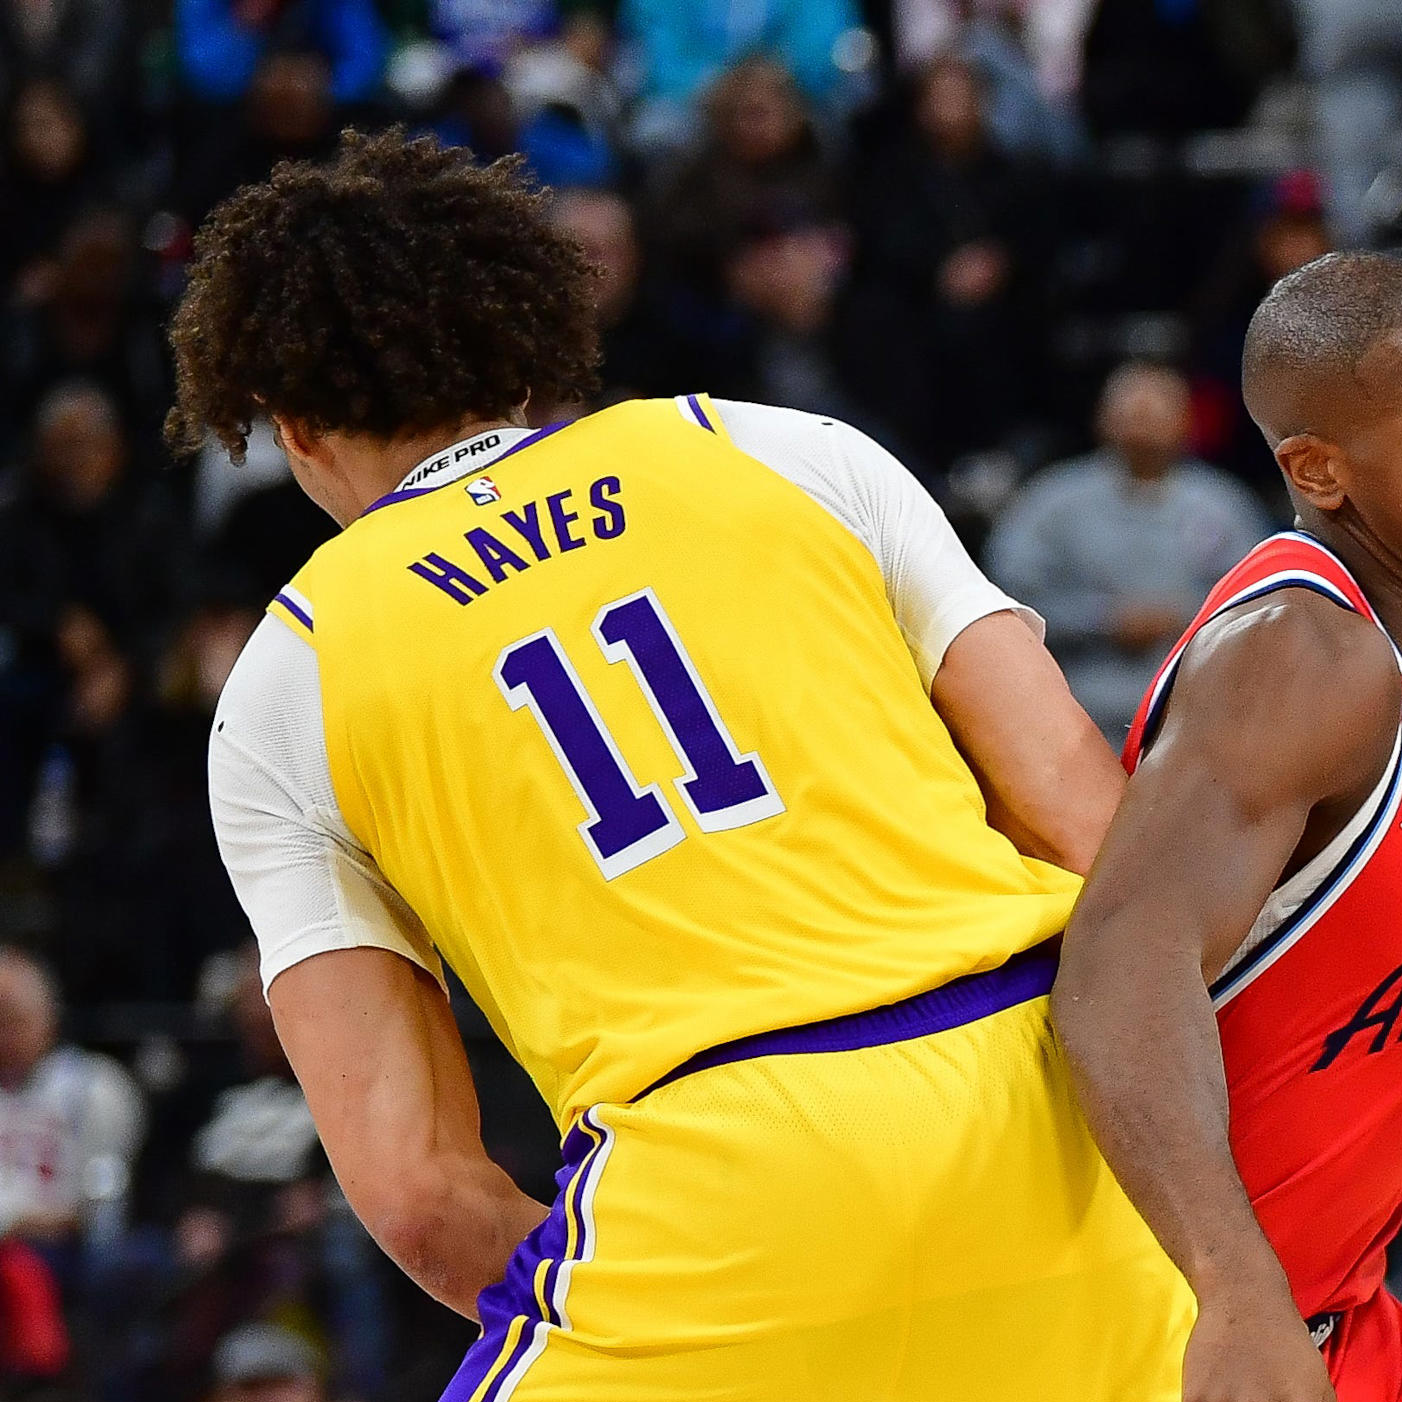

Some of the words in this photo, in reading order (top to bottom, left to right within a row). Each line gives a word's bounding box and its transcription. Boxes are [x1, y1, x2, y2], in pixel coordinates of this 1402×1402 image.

[402, 456, 450, 491] NIKE
[454, 434, 501, 463] PRO
[406, 475, 627, 607] HAYES
[491, 585, 788, 883] 11
